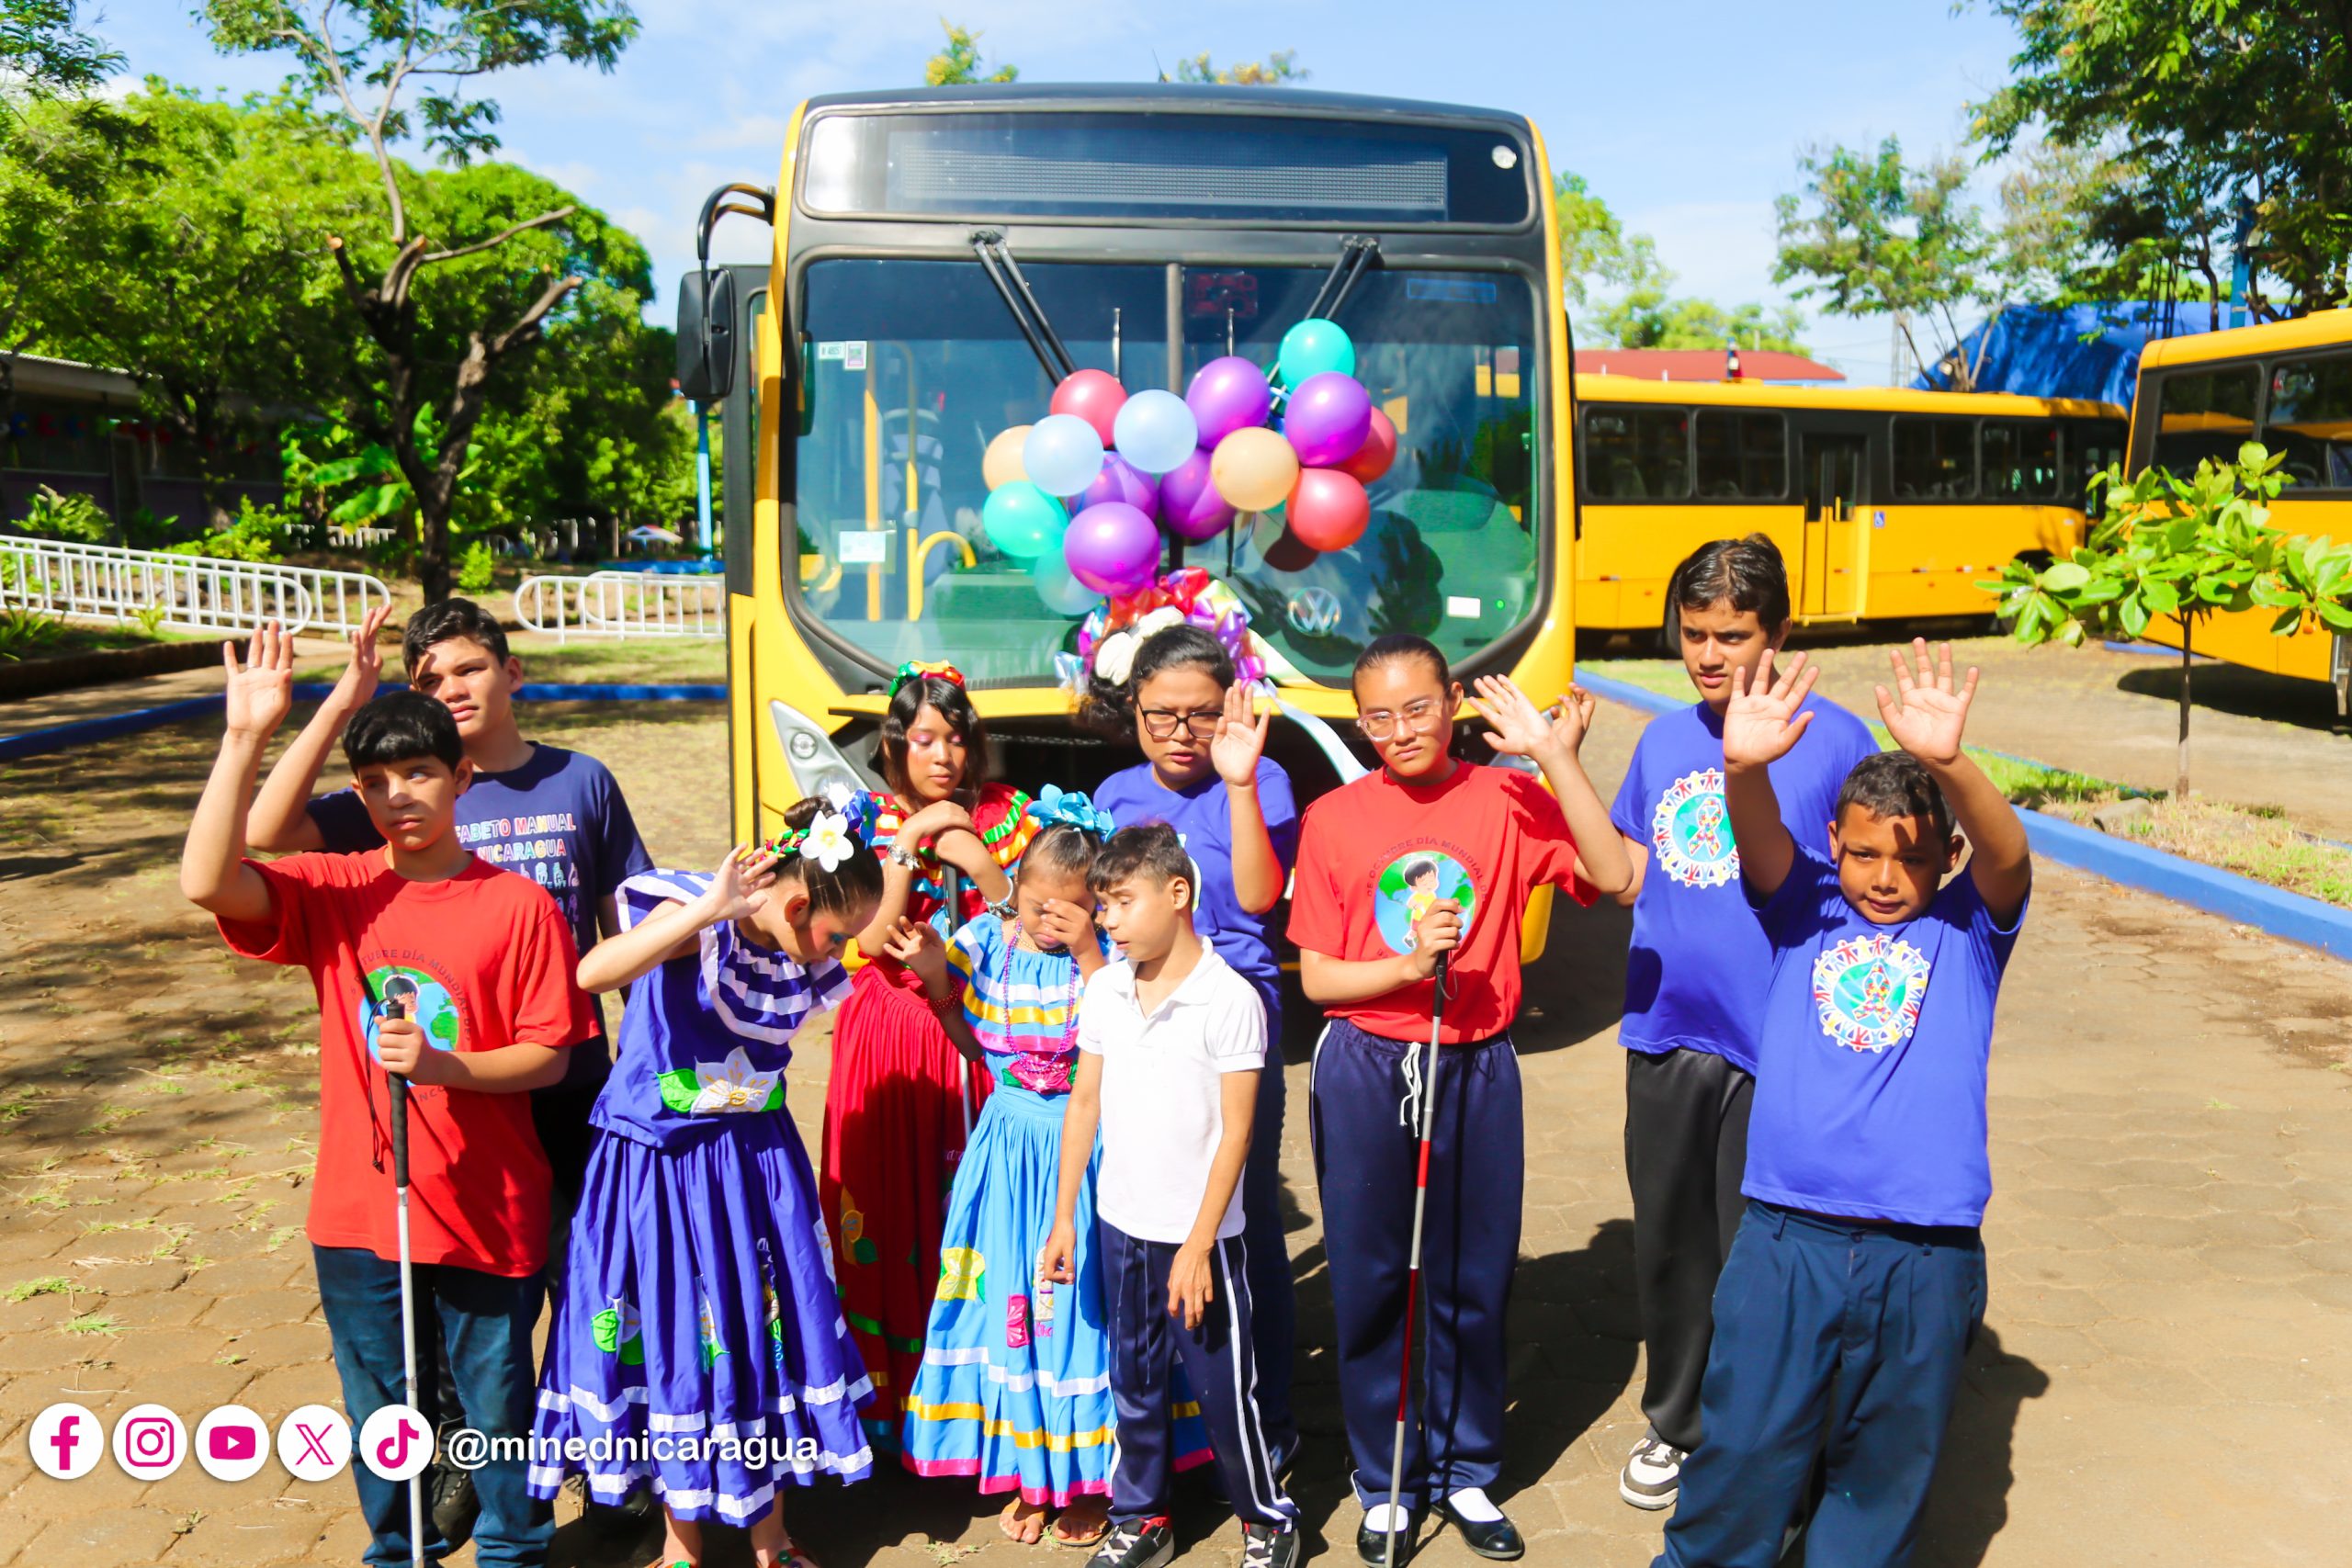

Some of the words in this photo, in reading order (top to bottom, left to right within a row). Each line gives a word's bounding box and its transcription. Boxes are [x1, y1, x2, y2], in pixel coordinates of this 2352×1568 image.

[514, 813, 577, 836] MANUAL
[477, 838, 568, 863] NICARAGUA
[1441, 840, 1484, 882] MUNDIAL
[427, 958, 469, 1014] MUNDIAL
